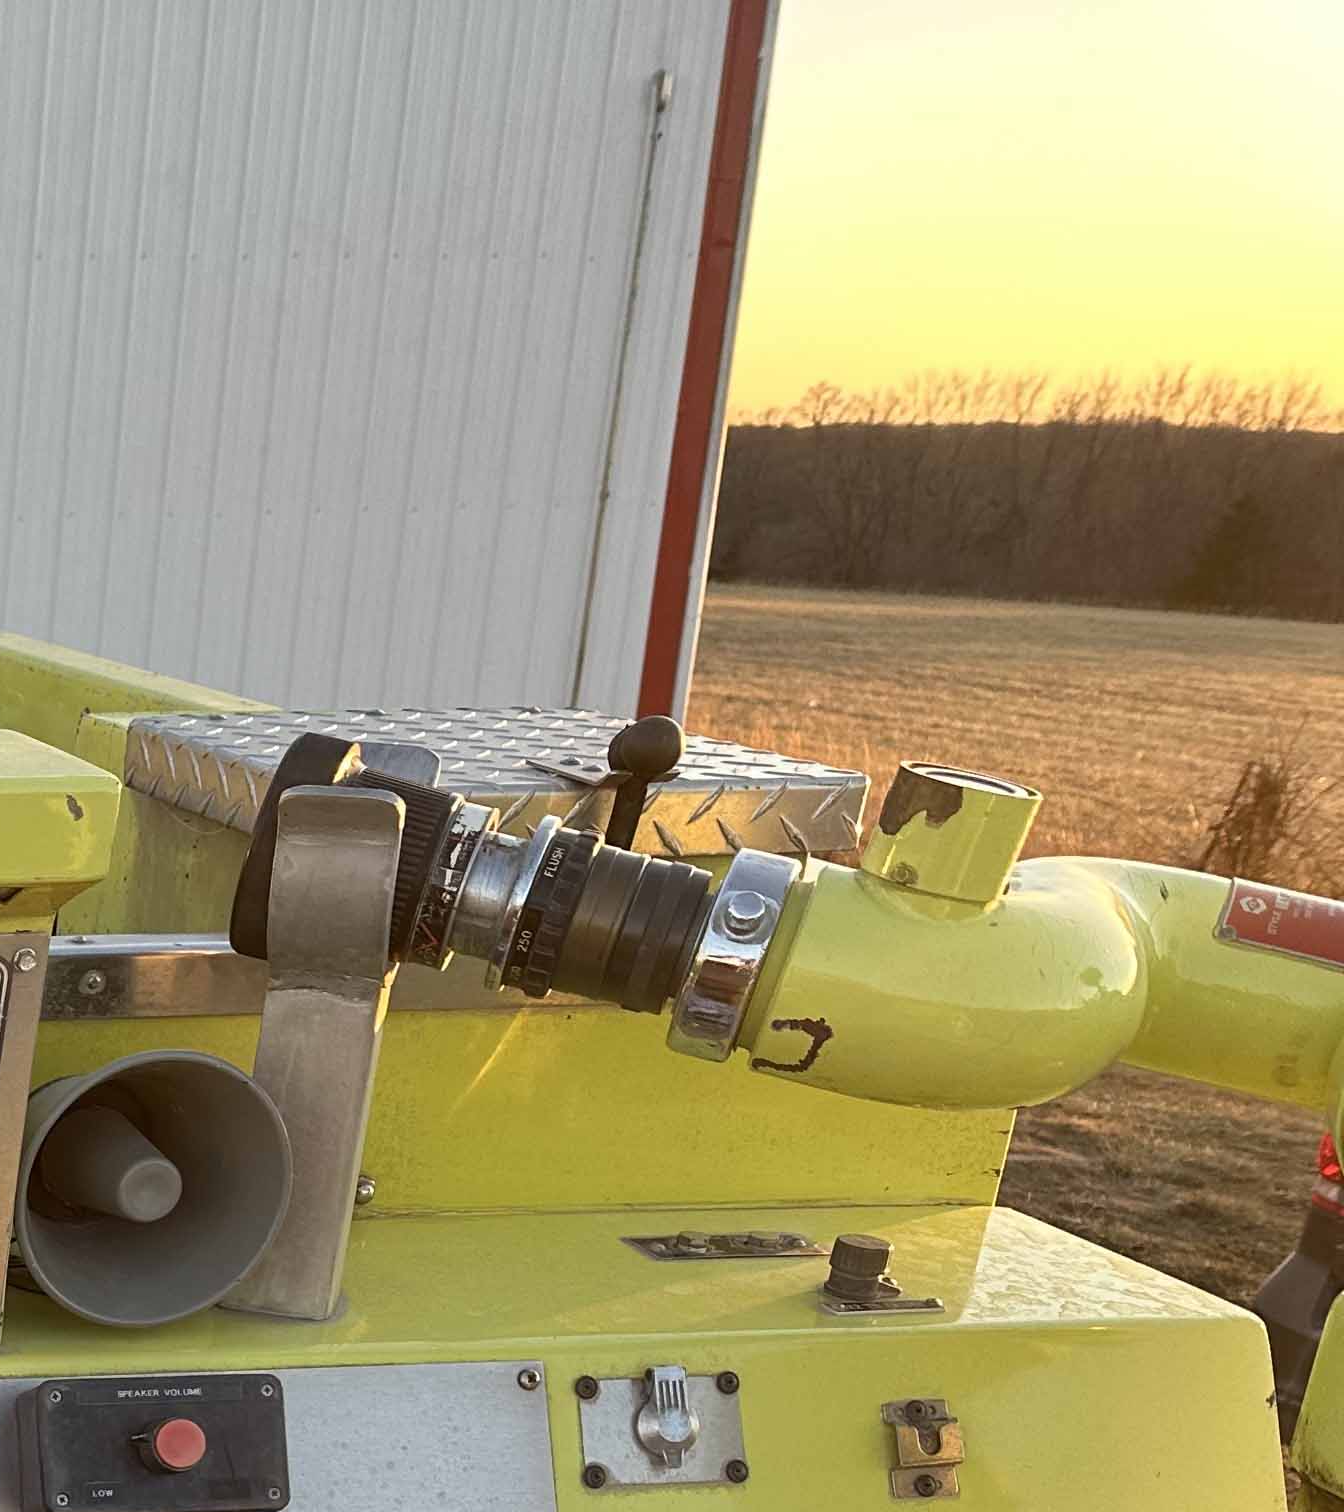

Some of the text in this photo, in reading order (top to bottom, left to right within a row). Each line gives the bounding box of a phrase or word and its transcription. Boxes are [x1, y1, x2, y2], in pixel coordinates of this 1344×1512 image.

[543, 847, 565, 878] FLUSH
[516, 930, 532, 953] 250
[117, 1387, 203, 1398] SPEAKER VOLUME
[92, 1489, 113, 1498] LOW
